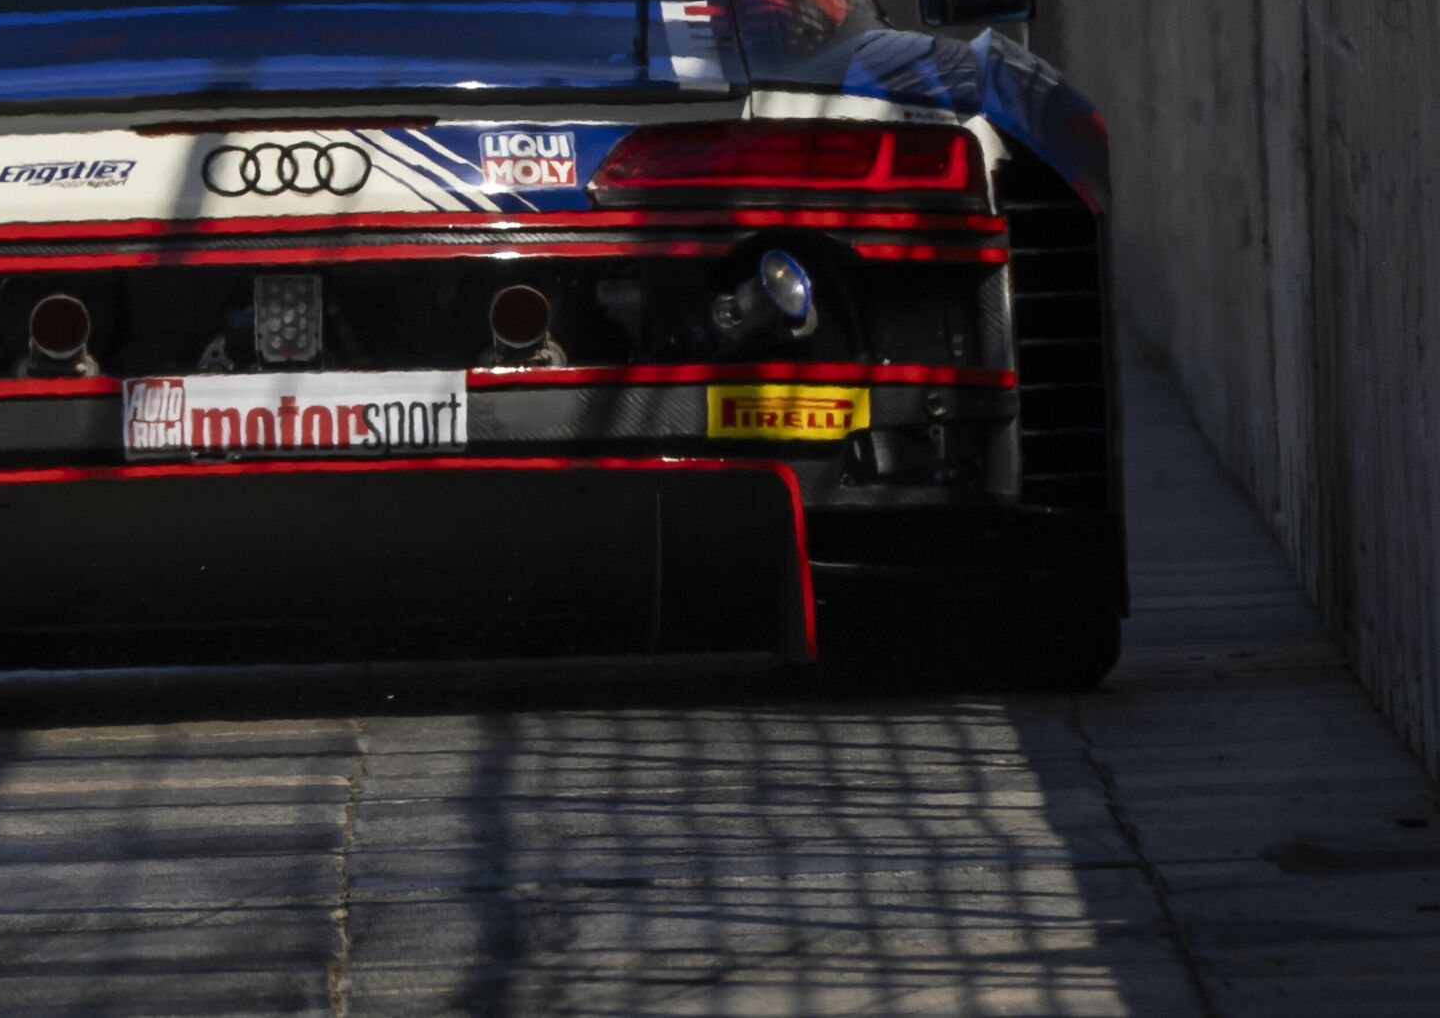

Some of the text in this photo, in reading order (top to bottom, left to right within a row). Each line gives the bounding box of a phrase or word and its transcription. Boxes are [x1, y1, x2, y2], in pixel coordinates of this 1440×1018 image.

[485, 133, 570, 158] LIQUI
[486, 159, 573, 184] MOLY
[191, 392, 461, 455] motorsport
[722, 397, 854, 429] PIRELLI
